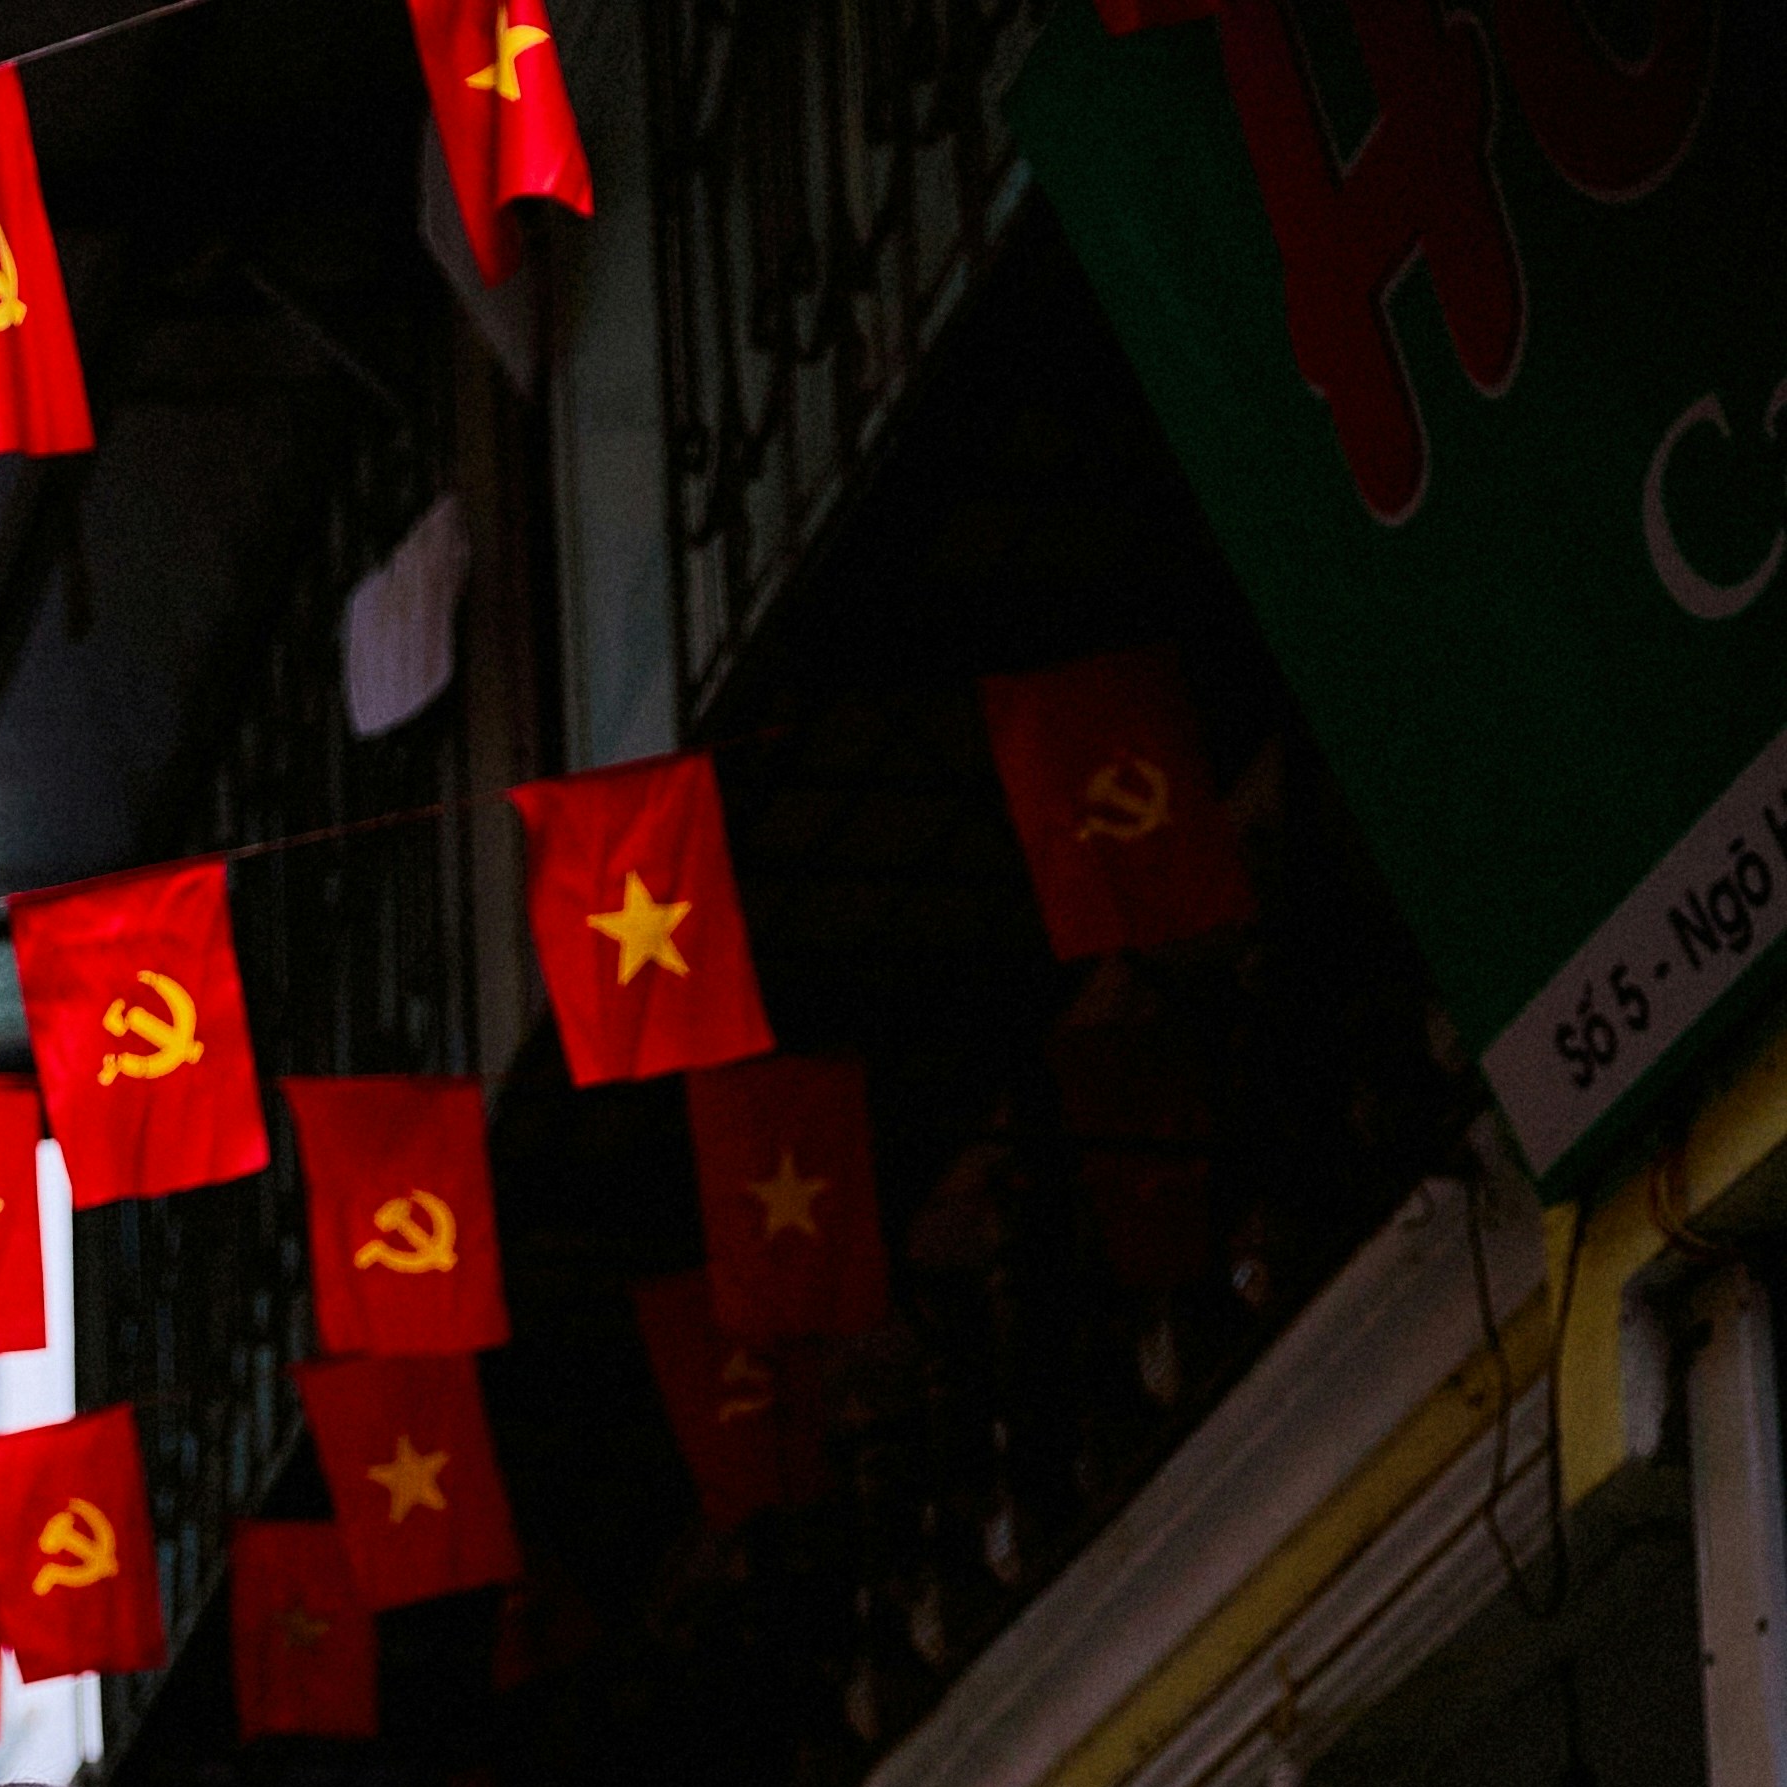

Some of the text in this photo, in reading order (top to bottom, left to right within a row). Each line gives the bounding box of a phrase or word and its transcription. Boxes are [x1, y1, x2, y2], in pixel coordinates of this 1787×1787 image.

[1554, 979, 1618, 1089] Số
[1608, 962, 1651, 1033] 5
[1665, 834, 1773, 971] Ngõ
